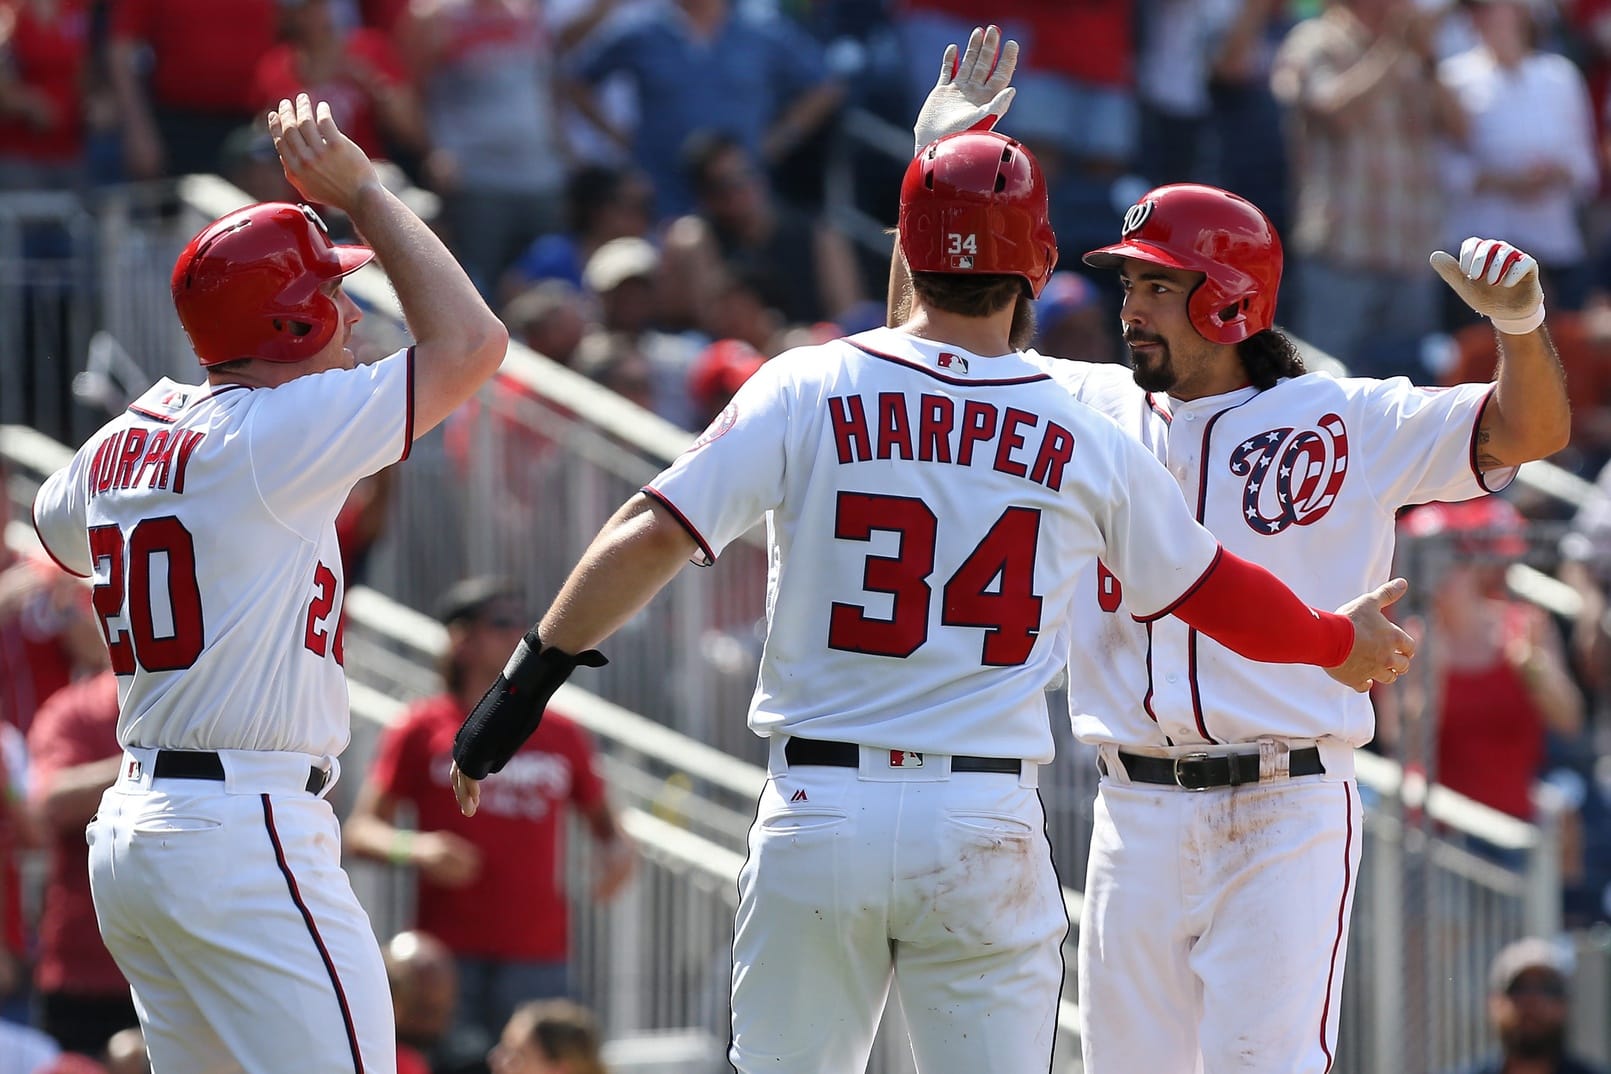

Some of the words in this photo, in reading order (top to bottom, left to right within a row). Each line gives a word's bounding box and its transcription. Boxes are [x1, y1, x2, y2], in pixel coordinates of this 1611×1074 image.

[948, 233, 977, 255] 34
[828, 392, 1075, 492] HARPER
[1229, 412, 1349, 536] W
[88, 515, 204, 676] 20
[828, 490, 1043, 667] 34
